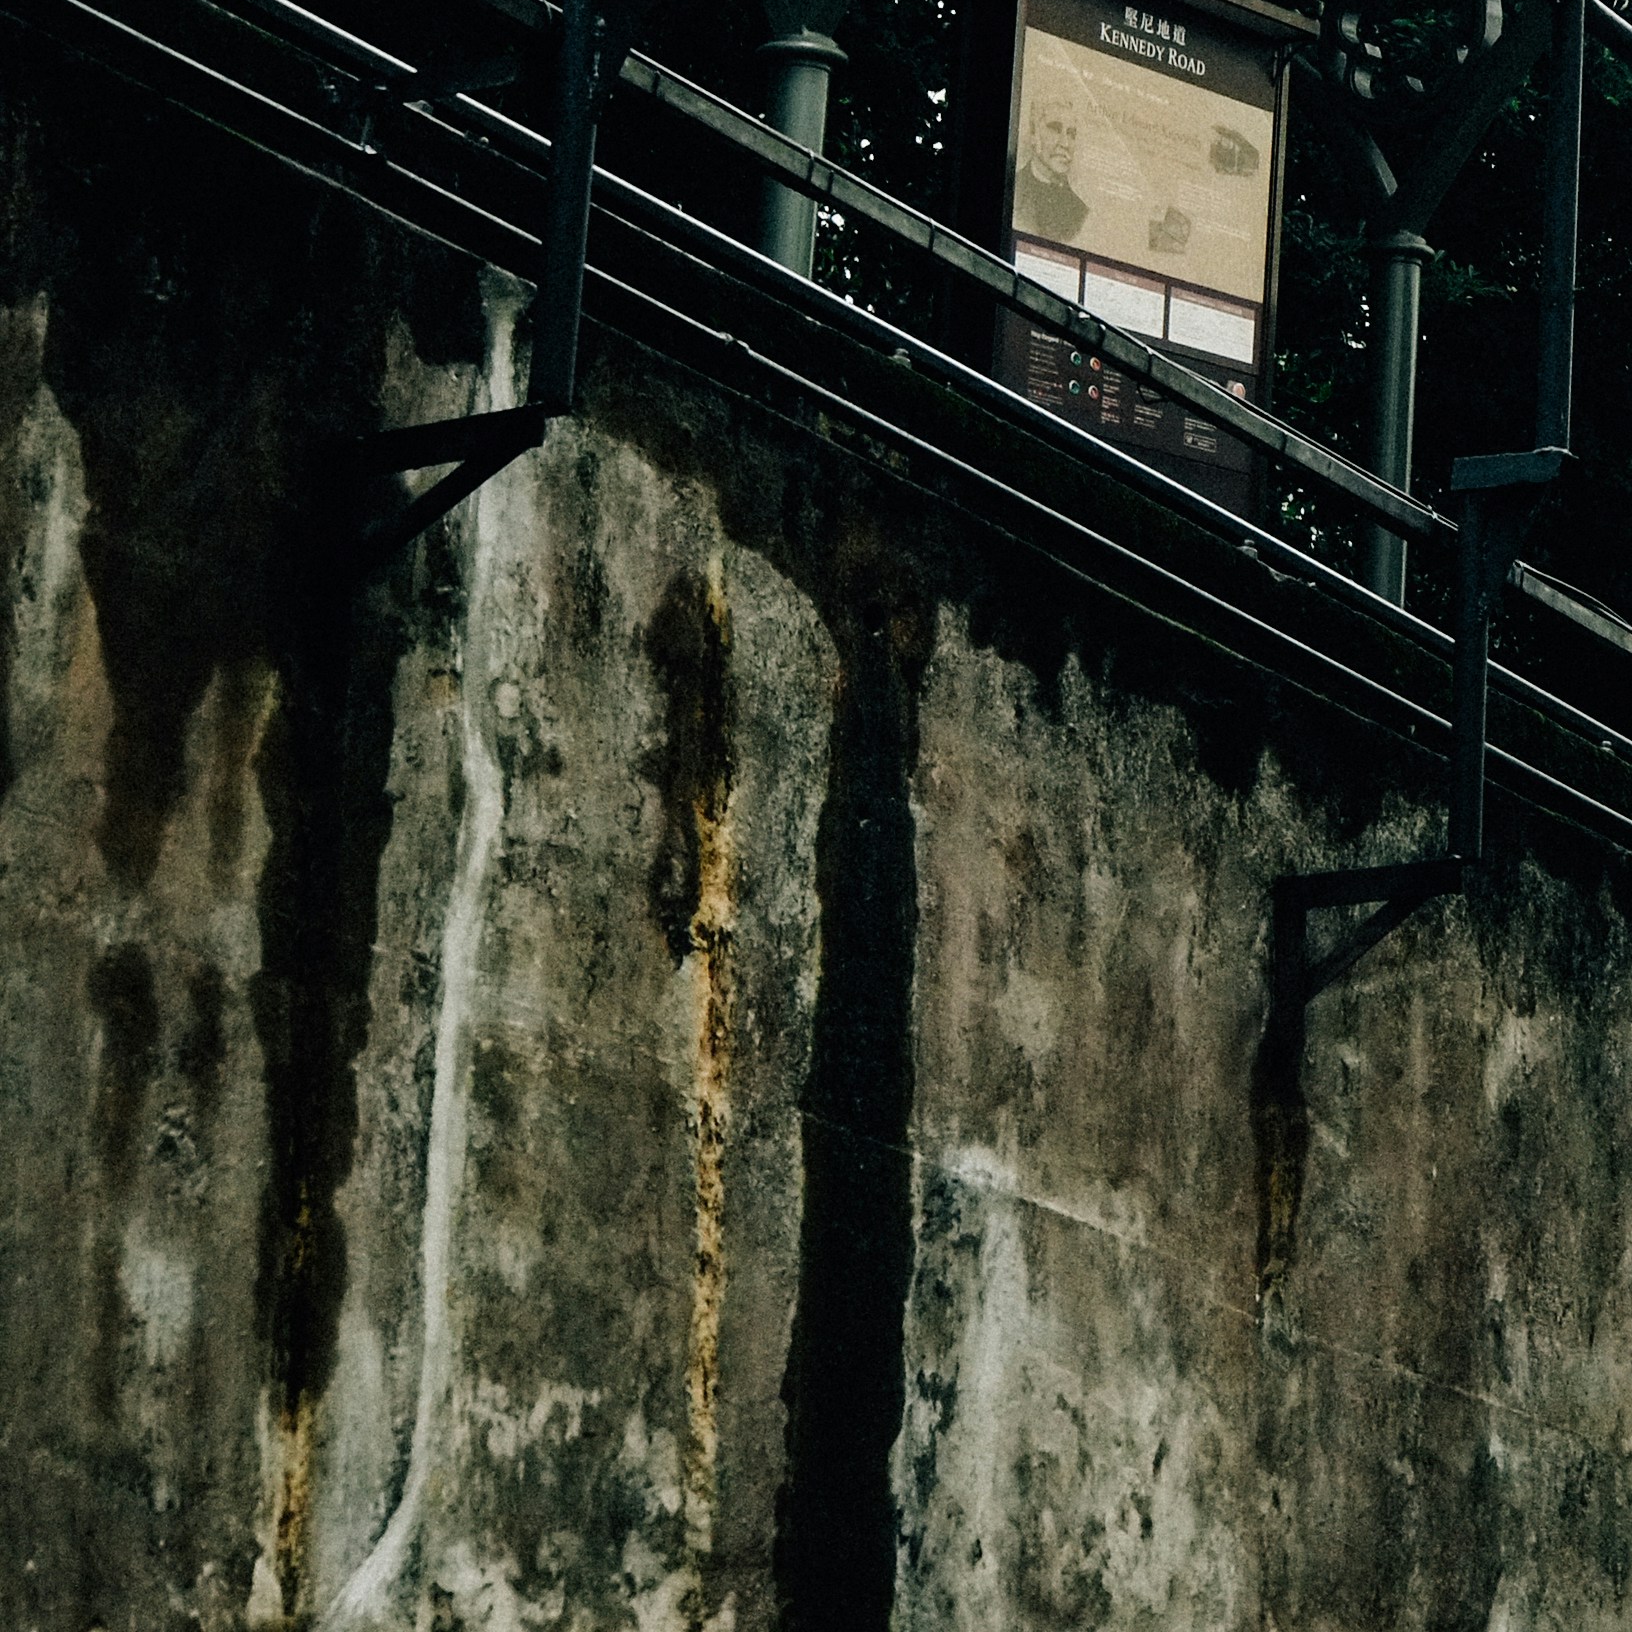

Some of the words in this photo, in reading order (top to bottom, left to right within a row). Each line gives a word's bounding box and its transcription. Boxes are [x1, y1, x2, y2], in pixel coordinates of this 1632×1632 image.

[1099, 21, 1166, 62] KENNEDY
[1167, 47, 1206, 76] ROAD
[1123, 6, 1187, 47] 堅尼地道
